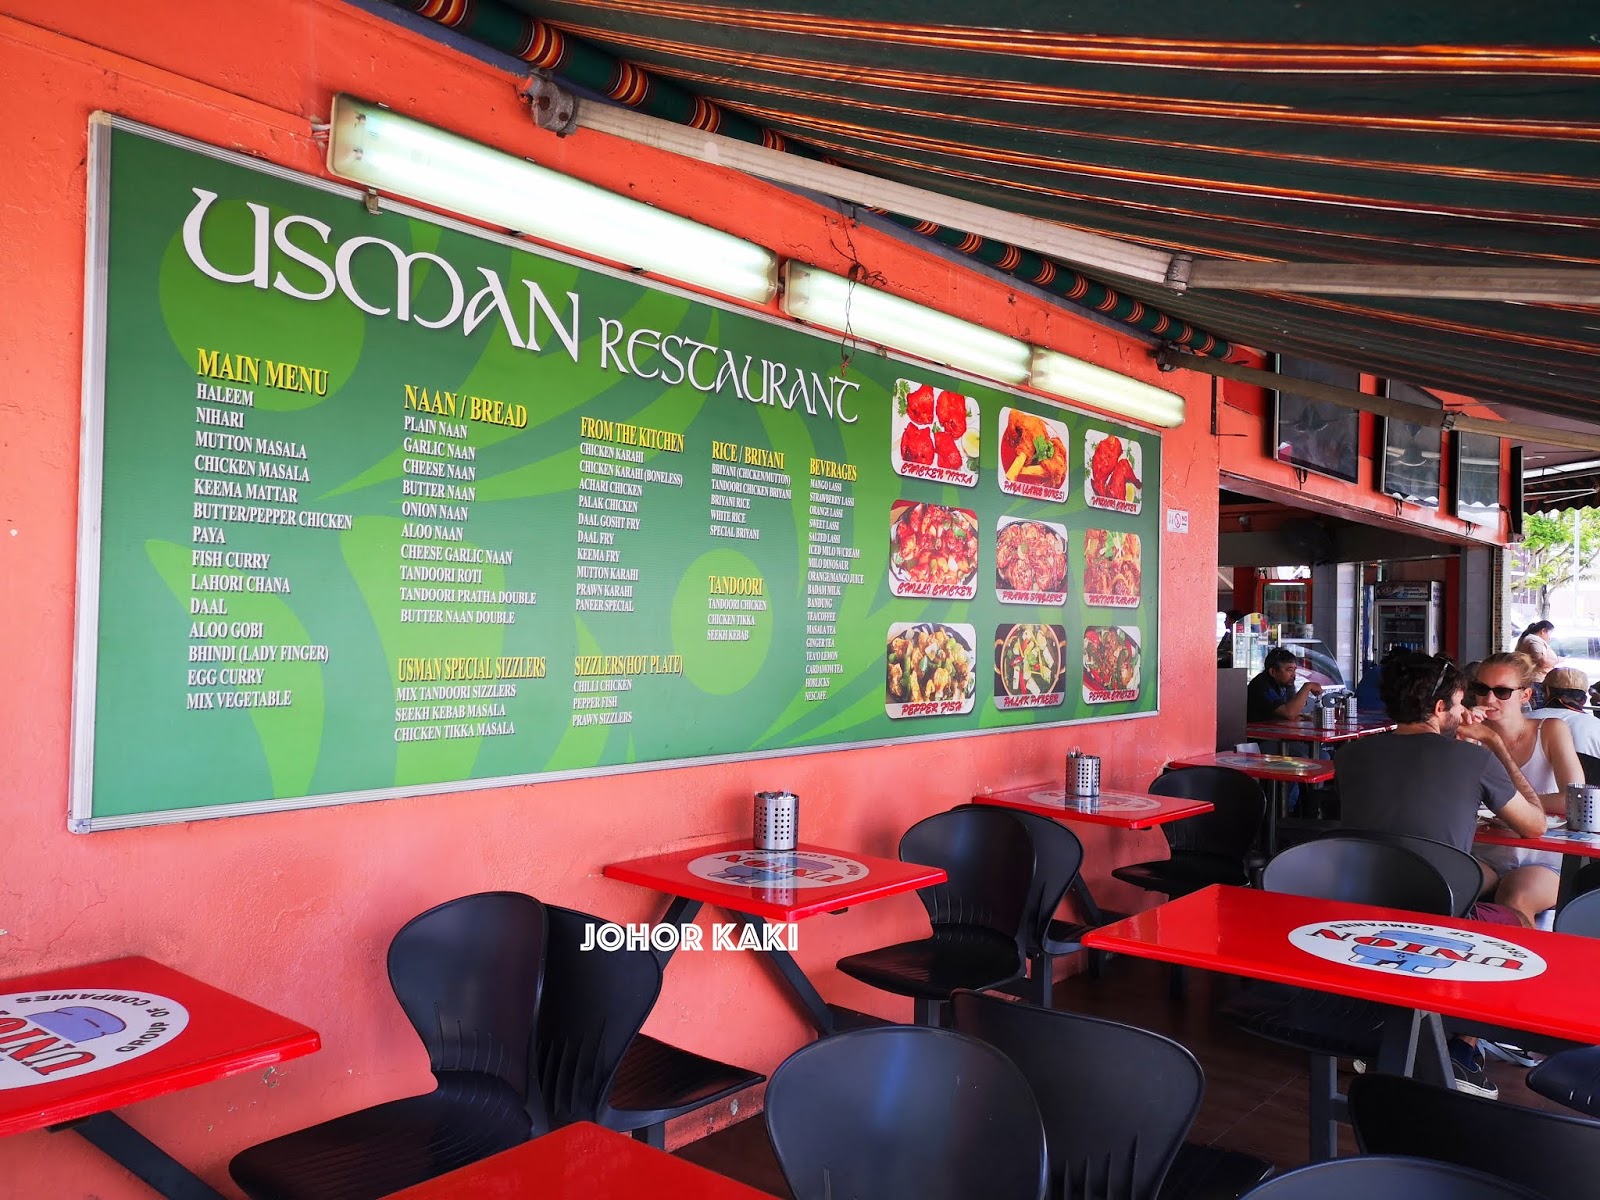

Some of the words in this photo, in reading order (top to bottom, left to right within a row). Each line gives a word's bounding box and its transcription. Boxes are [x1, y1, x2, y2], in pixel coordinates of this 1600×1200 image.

[183, 187, 578, 362] USMAN
[598, 317, 860, 423] RESTAURANT
[197, 347, 260, 384] MAIN
[265, 360, 328, 396] MENU
[197, 383, 254, 406] HALEEM
[404, 384, 457, 416] NAAN
[469, 396, 528, 427] BREAD
[196, 407, 244, 428] NIHARI
[404, 416, 436, 434] PLAIN
[439, 421, 468, 438] NAAN
[581, 416, 613, 441] FROM
[616, 423, 637, 444] THE
[639, 427, 685, 453] KITCHEN
[195, 431, 253, 452] MUTTON
[256, 438, 307, 459] MASALA
[404, 437, 445, 456] GARLIC
[447, 443, 475, 460] NAAN
[580, 442, 614, 458] CHICKEN
[616, 448, 644, 463] KARAHI
[712, 441, 737, 461] RICE
[745, 447, 785, 469] BRIYANI
[194, 455, 256, 475] CHICKEN
[258, 462, 310, 481] MASALA
[403, 458, 445, 477] CHEESE
[447, 464, 475, 480] NAAN
[580, 460, 614, 475] CHICKEN
[615, 465, 643, 480] KARAHI
[644, 469, 683, 487] (BONELESS)
[810, 458, 857, 481] BEVERAGES
[901, 463, 943, 481] CHICKEN
[946, 470, 972, 485] TIKKA
[194, 479, 242, 497] KEEMA
[246, 483, 298, 503] MATTAR
[402, 480, 445, 497] BUTTER
[447, 485, 475, 501] NAAN
[579, 478, 608, 492] ACHARI
[610, 482, 642, 496] CHICKEN
[711, 479, 742, 492] TANDOORI
[743, 483, 769, 496] CHICKEN
[769, 487, 792, 499] BRIYANI
[402, 501, 437, 517] ONION
[439, 505, 468, 520] NAAN
[579, 495, 603, 509] PALAK
[605, 498, 638, 512] CHICKEN
[711, 494, 735, 507] BRIYANI
[736, 497, 750, 509] RICE
[193, 502, 297, 525] BUTTER/PEPPER
[299, 511, 352, 529] CHICKEN
[578, 513, 599, 526] DAAL
[600, 515, 625, 528] GOSHT
[626, 518, 640, 530] FRY
[711, 509, 731, 521] WHITE
[732, 512, 746, 523] RICE
[192, 526, 225, 543] PAYA
[401, 524, 432, 539] ALOO
[435, 526, 463, 541] NAAN
[578, 530, 598, 543] DAAL
[600, 532, 614, 545] FRY
[710, 525, 735, 537] SPECIAL
[736, 527, 759, 539] BRIYANI
[192, 550, 222, 566] FISH
[225, 552, 270, 569] CURRY
[401, 544, 442, 560] CHEESE
[445, 547, 484, 562] GARLIC
[485, 550, 513, 564] NAAN
[577, 548, 604, 561] KEEMA
[606, 550, 621, 562] FRY
[400, 566, 455, 581] TANDOORI
[457, 569, 482, 583] ROTI
[577, 566, 609, 578] MUTTON
[610, 568, 639, 580] KARAHI
[191, 574, 244, 591] LAHORI
[246, 576, 290, 592] CHANA
[576, 583, 603, 595] PRAWN
[604, 585, 632, 597] KARAHI
[708, 576, 764, 595] TANDOORI
[897, 584, 931, 595] CHILLI
[932, 585, 972, 596] CHICKEN
[400, 587, 455, 601] TANDOORI
[458, 590, 497, 602] PRATHA
[499, 591, 536, 604] DOUBLE
[708, 598, 739, 609] TANDOORI
[741, 600, 767, 610] CHICKEN
[190, 598, 227, 614] DAAL
[576, 599, 604, 610] PANEER
[605, 600, 634, 611] SPECIAL
[400, 609, 443, 622] BUTTER
[445, 610, 473, 623] NAAN
[476, 611, 515, 624] DOUBLE
[189, 622, 227, 637] ALOO
[230, 622, 263, 637] GOBI
[189, 646, 236, 661] BHINDI
[239, 646, 278, 663] (LADY
[280, 646, 329, 663] FINGER)
[188, 669, 216, 685] EGG
[219, 669, 264, 684] CURRY
[399, 657, 442, 681] USMAN
[445, 657, 493, 679] SPECIAL
[495, 656, 546, 678] SIZZLERS
[397, 687, 417, 701] MIX
[419, 686, 470, 700] TANDOORI
[473, 684, 516, 698] SIZZLERS
[574, 681, 598, 692] CHILLI
[600, 679, 632, 691] CHICKEN
[186, 693, 214, 709] MIX
[216, 690, 291, 708] VEGETABLE
[573, 697, 600, 709] PEPPER
[602, 696, 617, 707] FISH
[902, 703, 938, 715] PEPPER
[941, 701, 962, 713] FISH
[395, 707, 429, 721] SEEKH
[432, 705, 465, 719] KEBAB
[468, 704, 505, 717] MASALA
[572, 714, 598, 726] PRAWN
[599, 711, 632, 724] SIZZLERS
[394, 726, 441, 741] CHICKEN
[444, 724, 474, 738] TIKKA
[476, 722, 515, 736] MASALA
[1329, 923, 1433, 931] COMPANIES
[1310, 928, 1524, 971] UNION
[1483, 940, 1528, 959] GROUP
[16, 993, 151, 1006] COMPANIES
[146, 1007, 170, 1017] OF
[115, 1022, 170, 1053] GROUP
